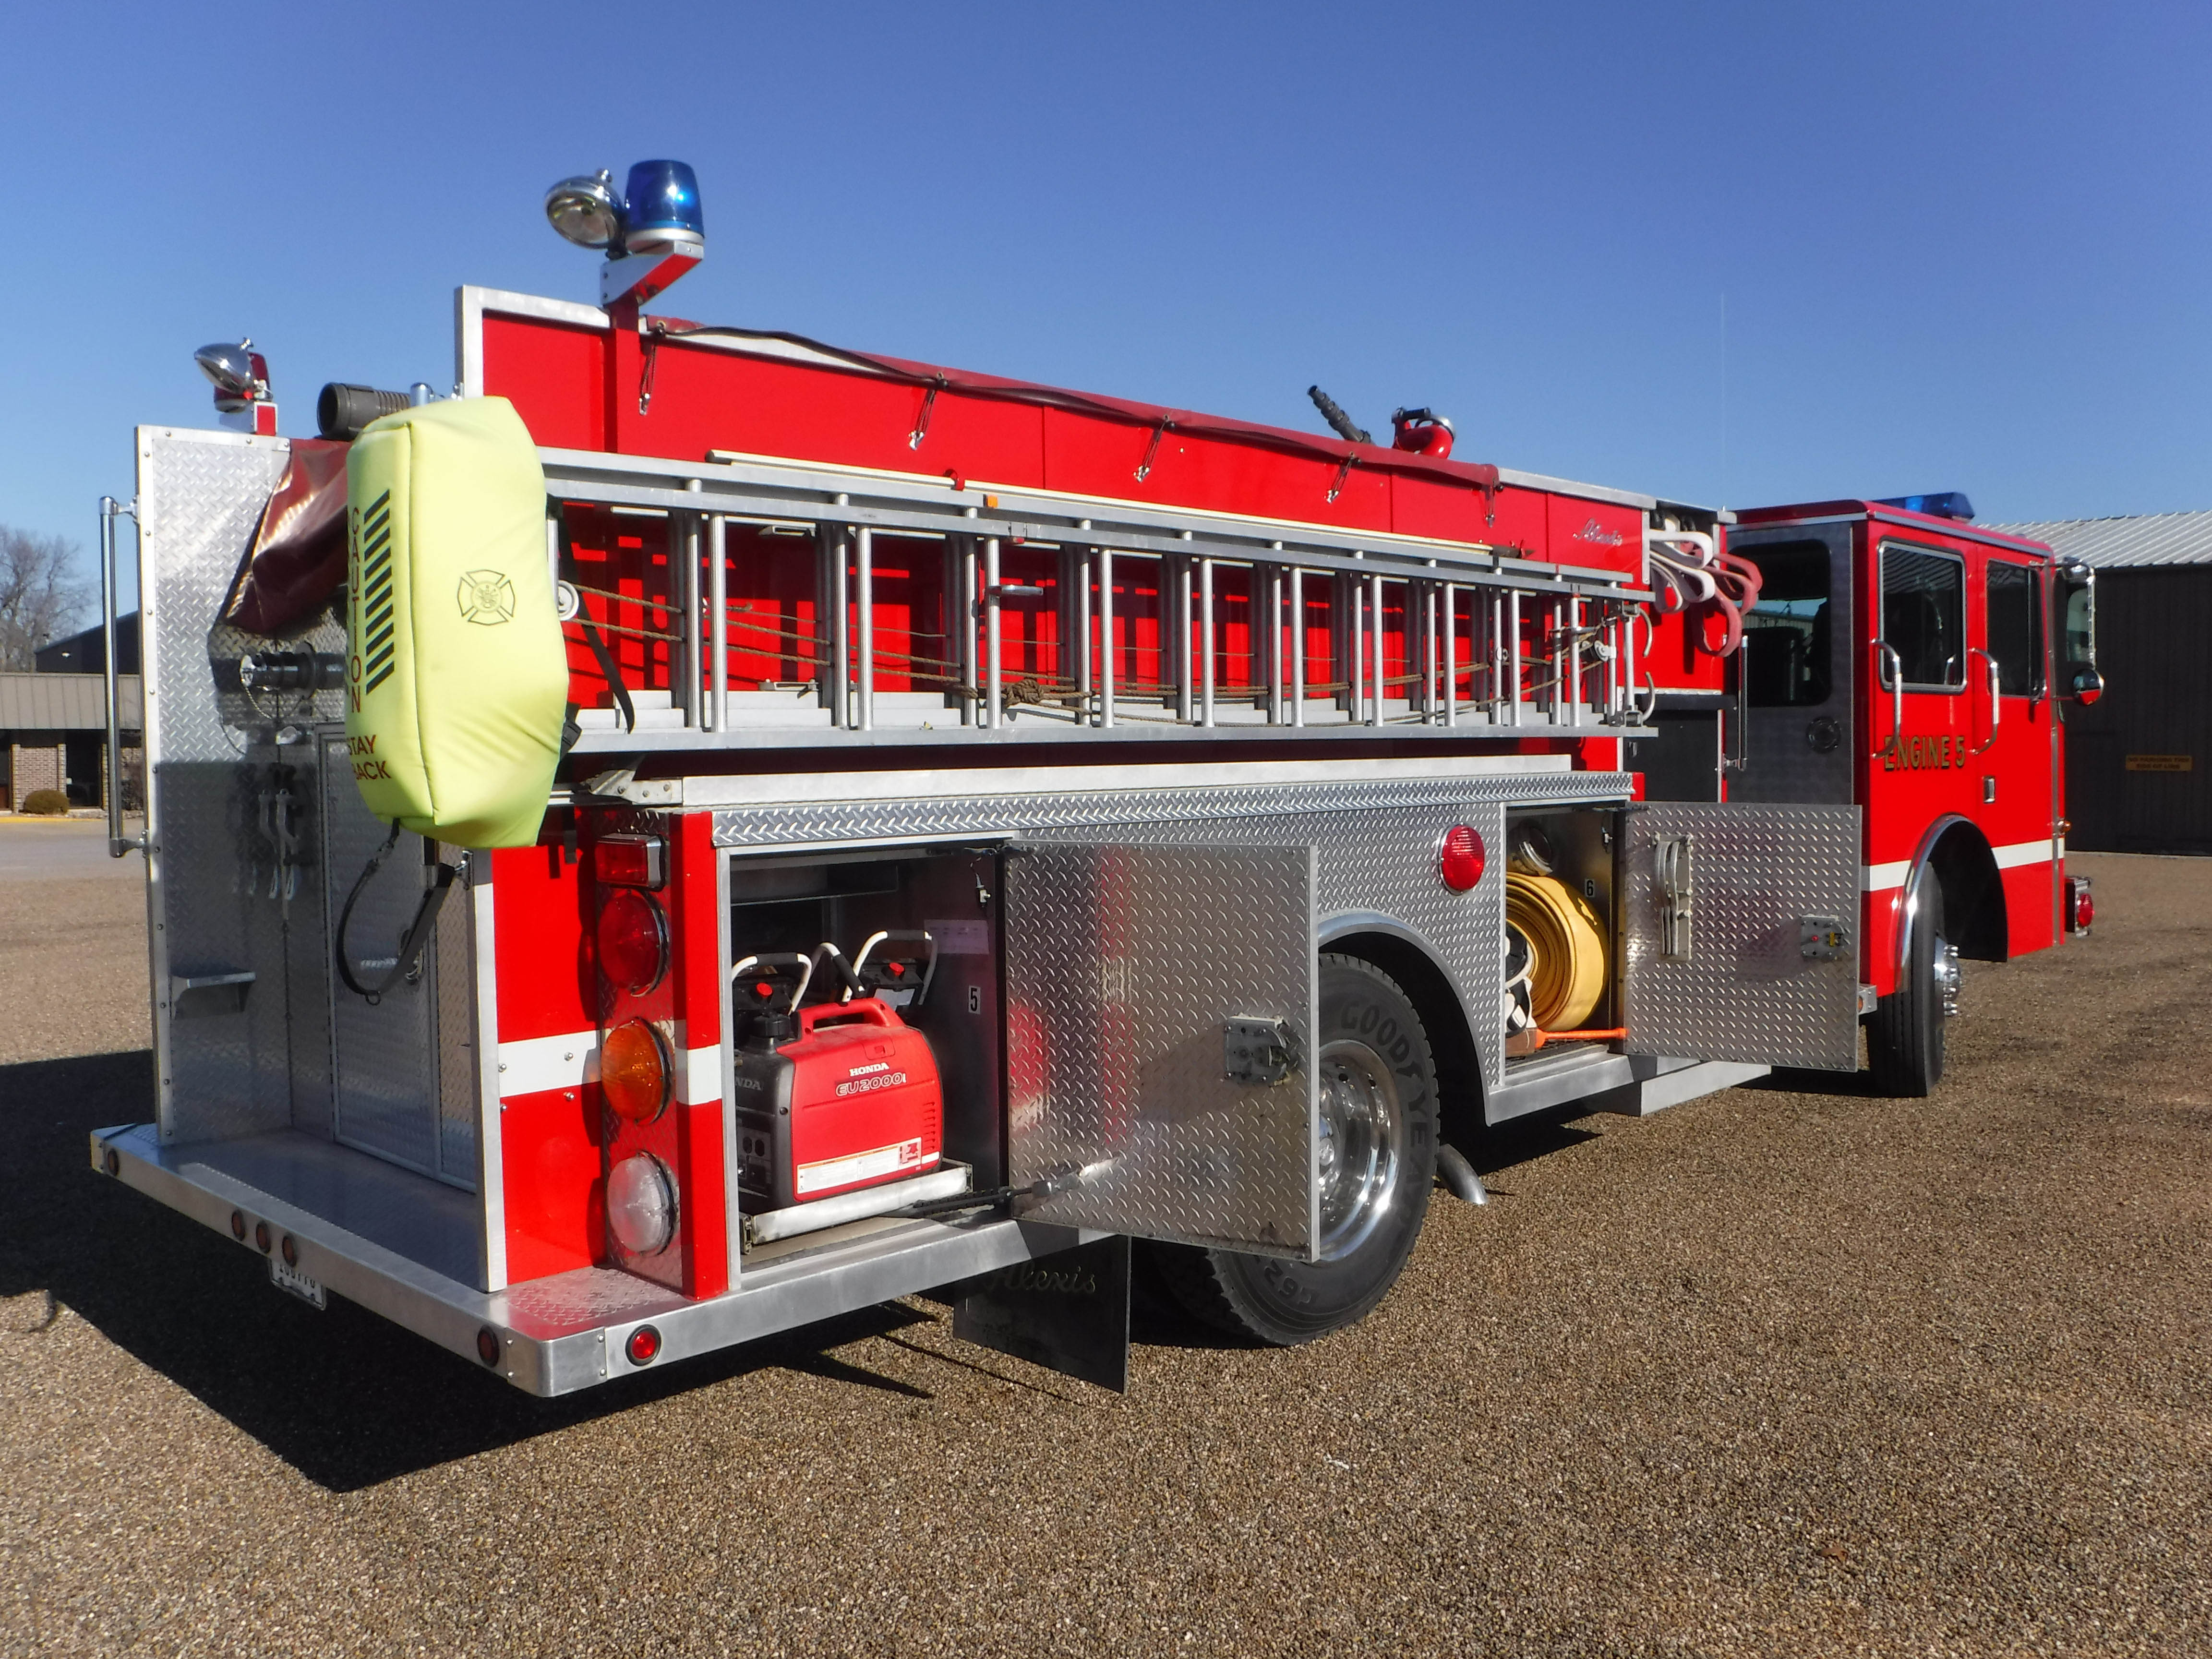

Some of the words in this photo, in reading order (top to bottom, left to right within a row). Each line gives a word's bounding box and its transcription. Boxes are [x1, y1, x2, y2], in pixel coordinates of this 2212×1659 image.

[351, 507, 361, 713] CAUTION
[1885, 736, 1950, 770] ENGINE
[1956, 736, 1965, 768] 5
[1587, 880, 1593, 896] 6
[970, 987, 977, 1012] 5
[849, 1062, 890, 1077] HONDA
[735, 1076, 762, 1091] NDA
